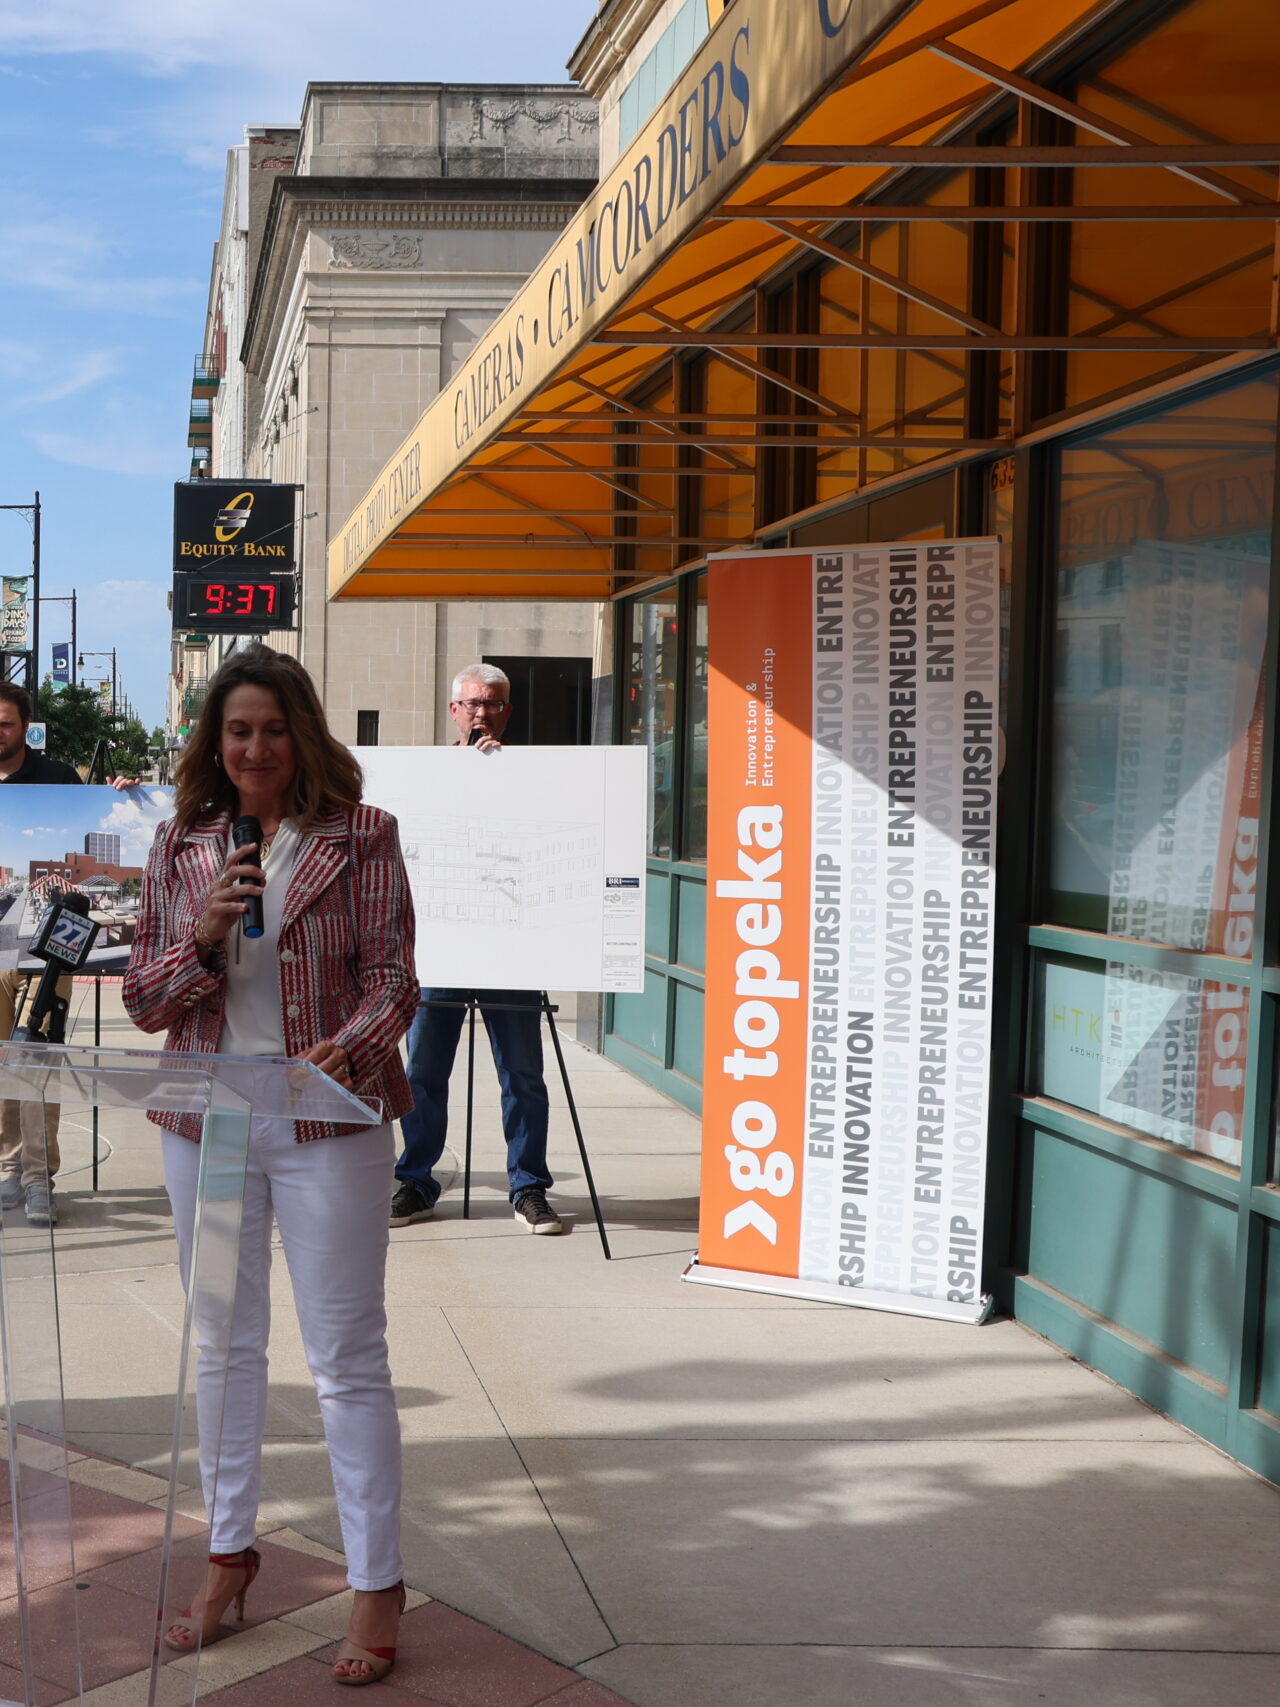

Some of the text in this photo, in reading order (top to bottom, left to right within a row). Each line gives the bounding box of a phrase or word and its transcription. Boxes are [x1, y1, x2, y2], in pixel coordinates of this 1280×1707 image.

[366, 483, 387, 549] PHOTO
[388, 441, 422, 520] CENTER
[454, 312, 525, 450] CAMERAS
[548, 18, 750, 348] CAMCORDERS
[3, 619, 26, 628] DAYS
[4, 610, 26, 619] DINO
[180, 541, 286, 559] EQUITY BANK
[205, 584, 276, 614] 9:37
[816, 553, 843, 652] ENTRE
[745, 682, 757, 786] Innovation &
[761, 648, 776, 787] Entrepreneurship
[816, 661, 843, 845] INNOVATION
[888, 548, 917, 847] ENTREPRENEURSHI
[923, 690, 954, 881] INNOVATION
[52, 918, 90, 947] 27
[848, 692, 880, 1003] ENTREPRENEURSHIP
[957, 690, 993, 1010] ENTREPRENEURSHIP
[47, 942, 78, 961] NEWS
[716, 804, 800, 1198] go topeka
[808, 853, 841, 1159] ENTREPRENEURSHIP
[882, 857, 915, 1043] INNOVATION
[1051, 1003, 1102, 1042] HTK
[842, 1011, 874, 1196] INNOVATION
[914, 889, 951, 1204] ENTREPRENEURSHIP
[950, 1018, 987, 1209] INNOVATION
